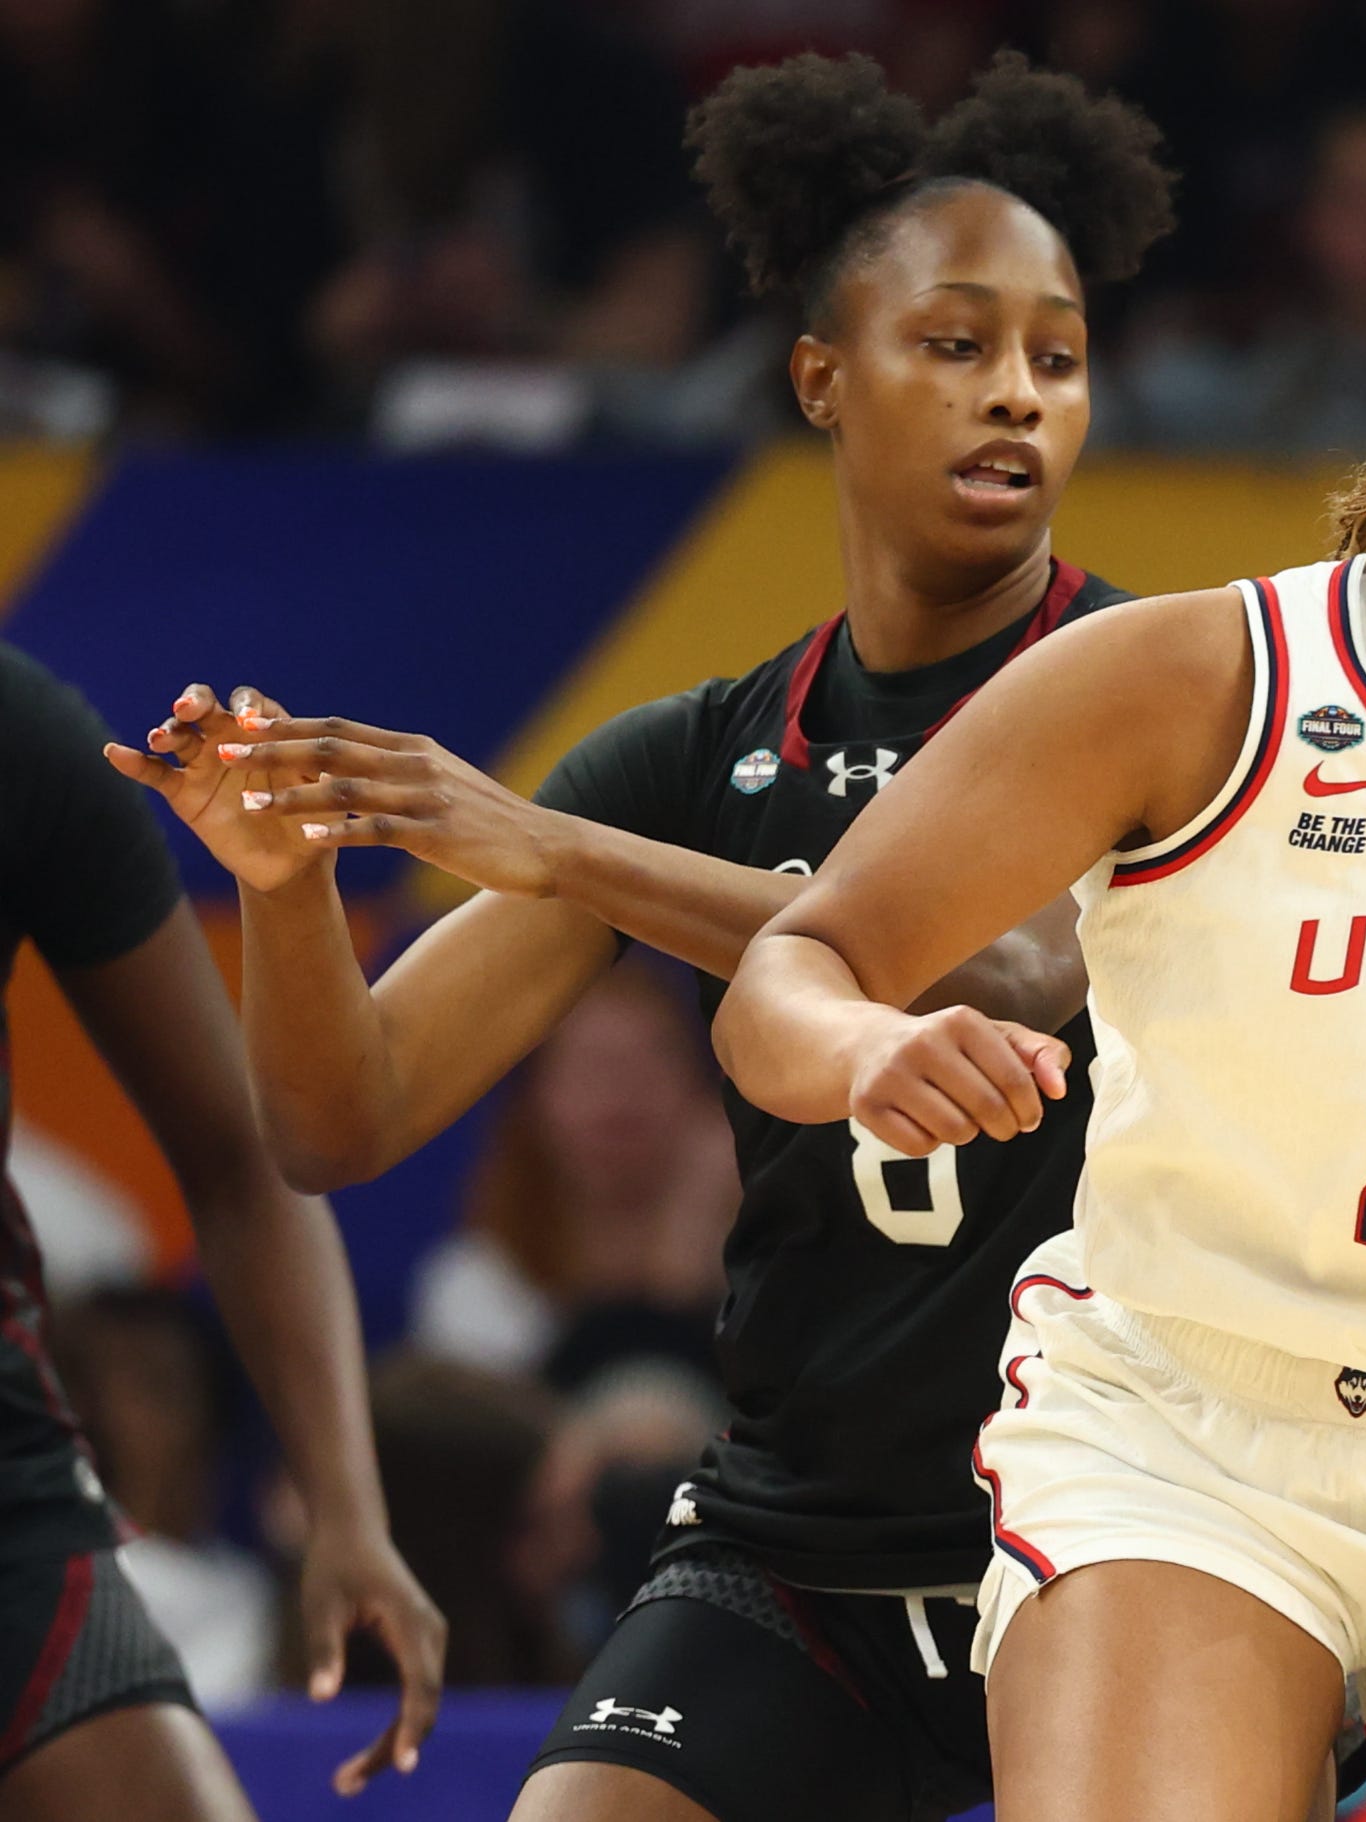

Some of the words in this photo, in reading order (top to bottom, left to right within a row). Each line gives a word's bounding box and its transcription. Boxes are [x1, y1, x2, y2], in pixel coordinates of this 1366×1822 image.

[1302, 719, 1331, 734] FINAL
[1333, 721, 1362, 736] FOUR
[1297, 811, 1326, 831] BE
